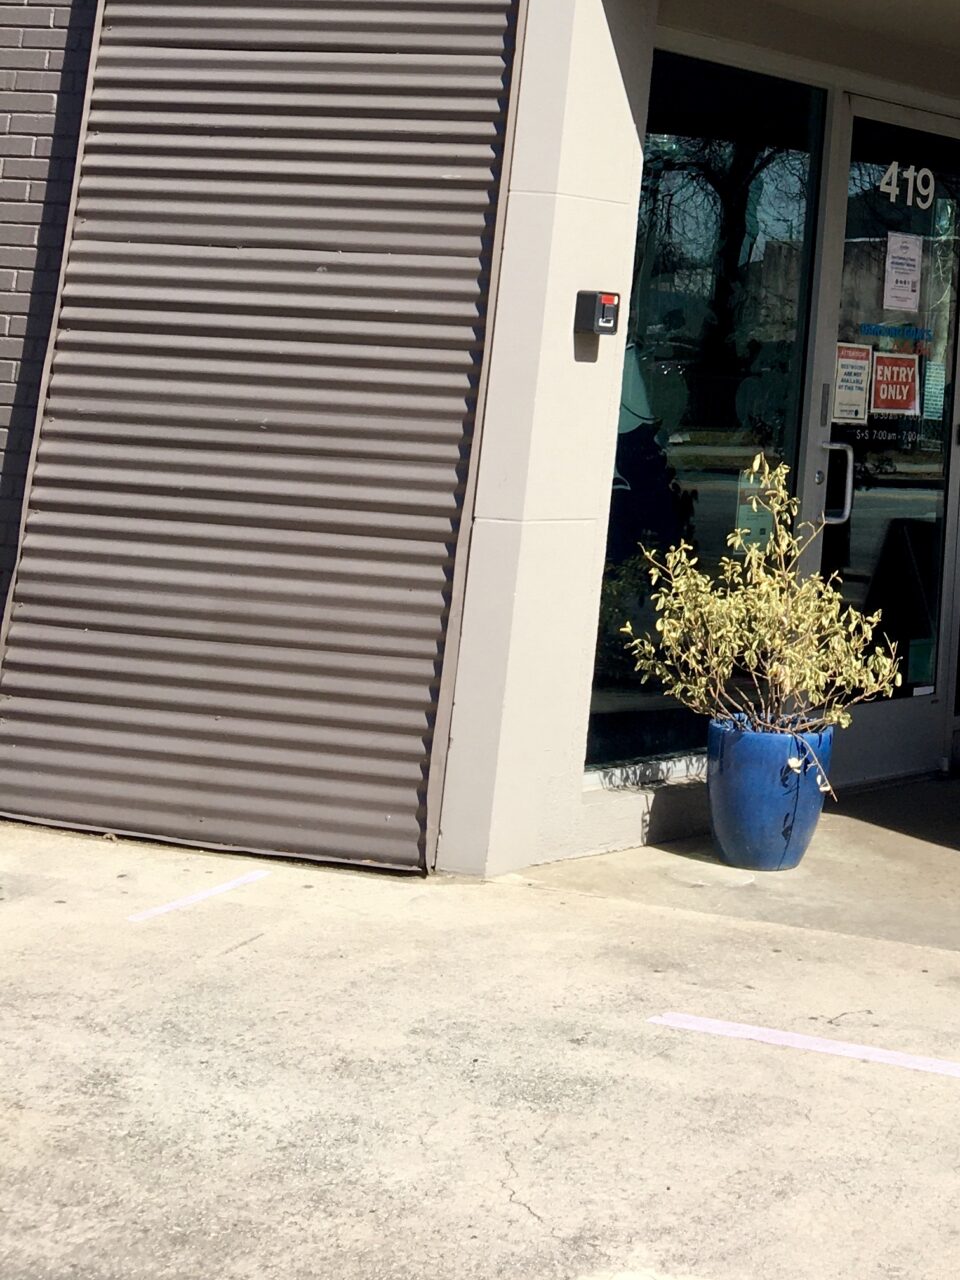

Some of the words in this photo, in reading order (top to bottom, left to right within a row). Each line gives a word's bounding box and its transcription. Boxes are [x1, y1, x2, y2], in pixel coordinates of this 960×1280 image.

[880, 161, 935, 210] 419
[877, 366, 914, 382] ENTRY
[880, 384, 909, 400] ONLY
[872, 430, 887, 440] 7:00
[887, 432, 897, 440] am
